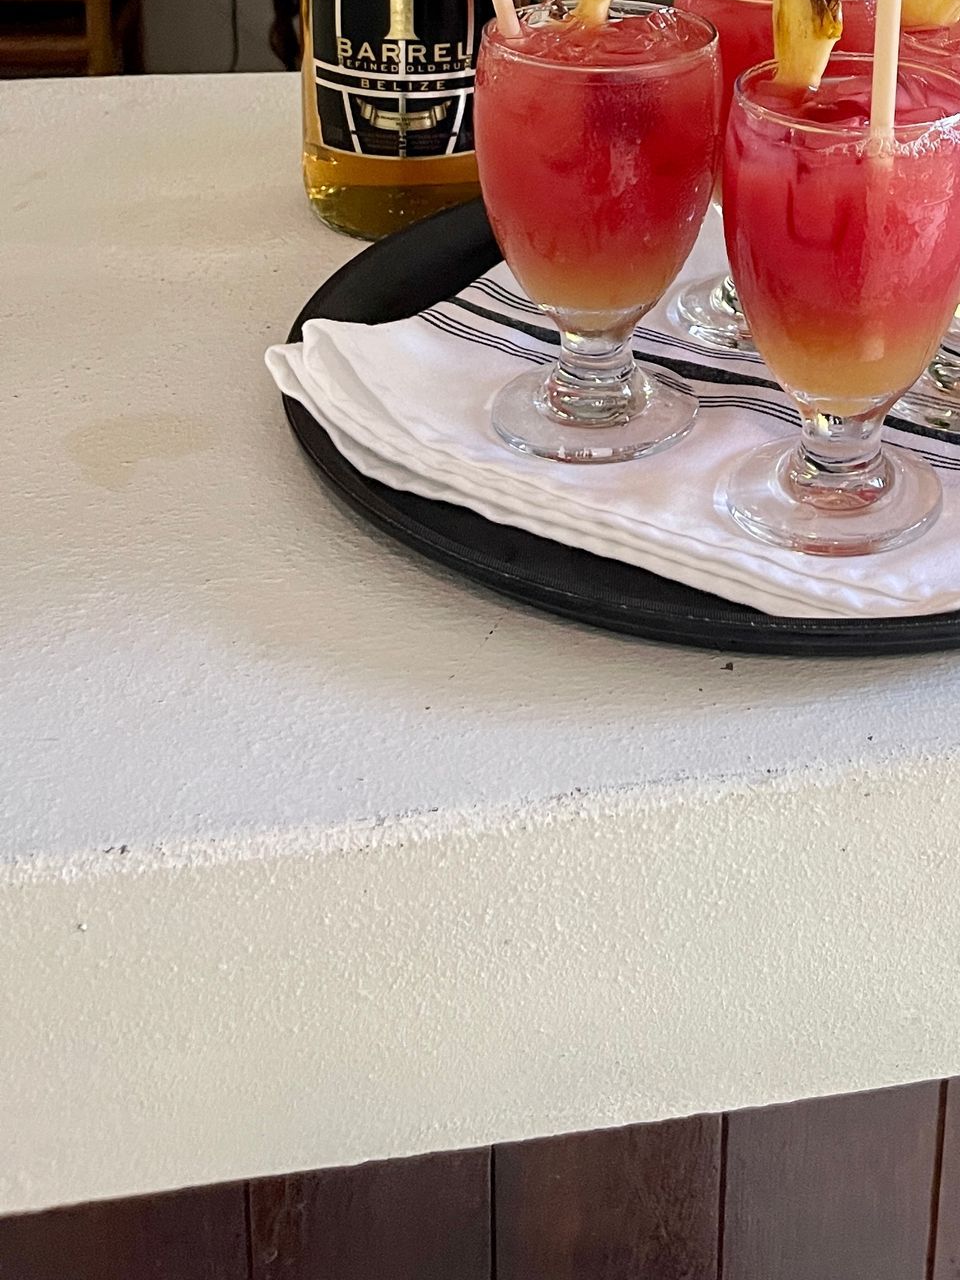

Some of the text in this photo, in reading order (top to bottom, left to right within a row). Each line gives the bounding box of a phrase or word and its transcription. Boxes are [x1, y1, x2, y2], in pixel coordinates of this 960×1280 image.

[337, 36, 472, 63] BARREL
[406, 64, 436, 73] OLD
[361, 78, 446, 92] BELIZE
